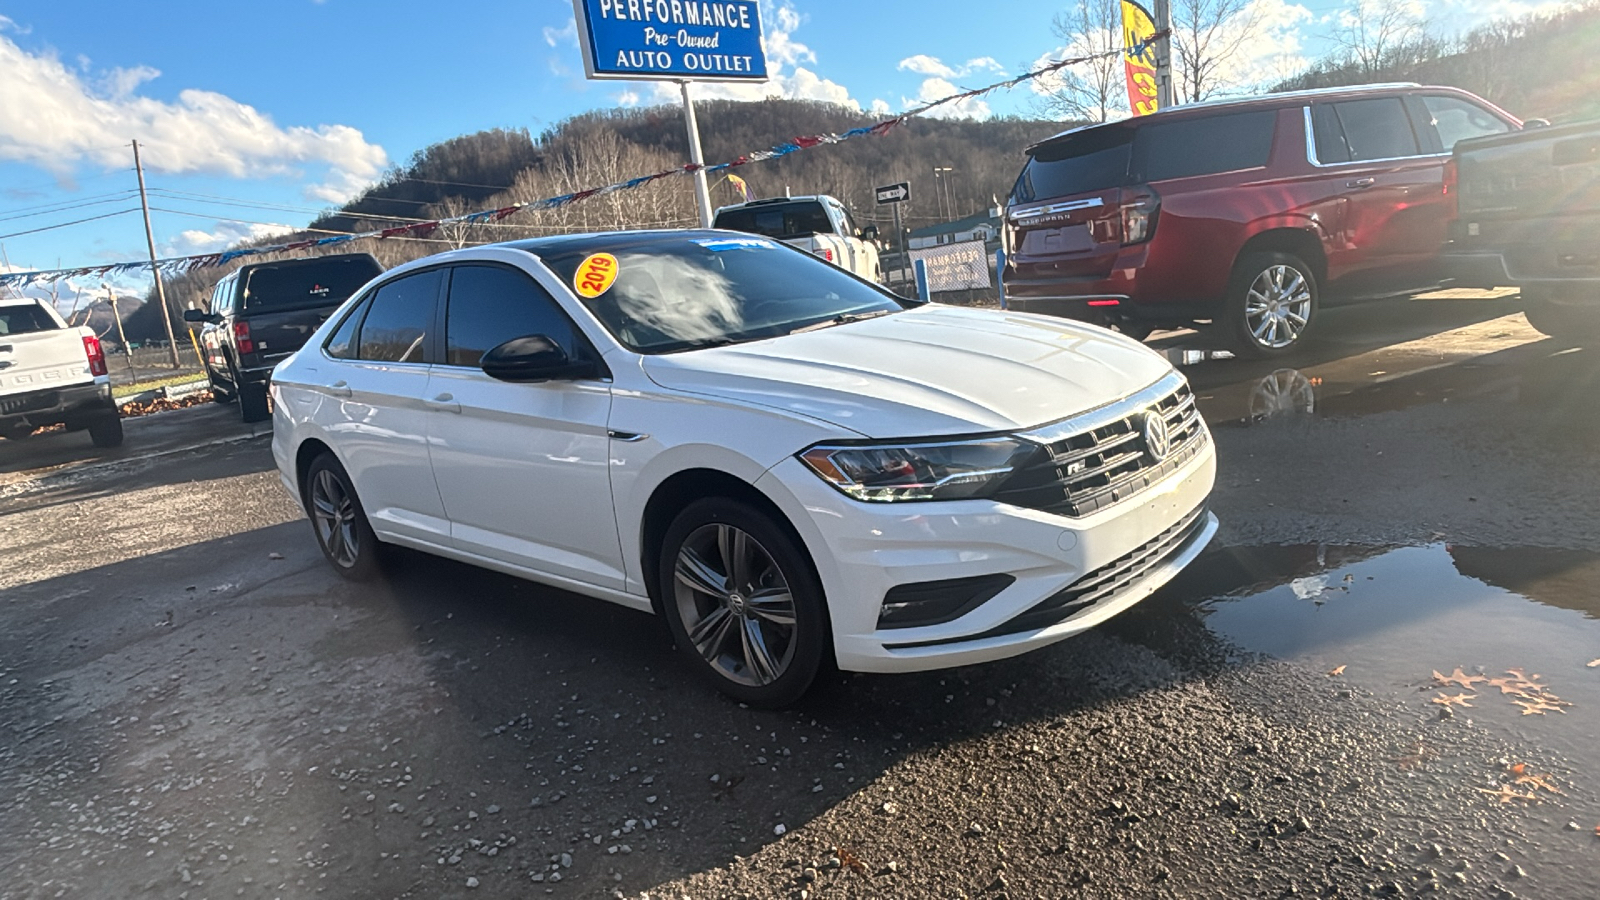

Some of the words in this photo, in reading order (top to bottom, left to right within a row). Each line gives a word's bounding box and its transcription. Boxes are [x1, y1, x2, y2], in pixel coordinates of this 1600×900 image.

[601, 0, 751, 29] PERFORMANCE
[643, 27, 720, 49] Pre-Owned
[616, 50, 672, 69] AUTO
[683, 52, 752, 72] OUTLET
[581, 257, 612, 292] 2019
